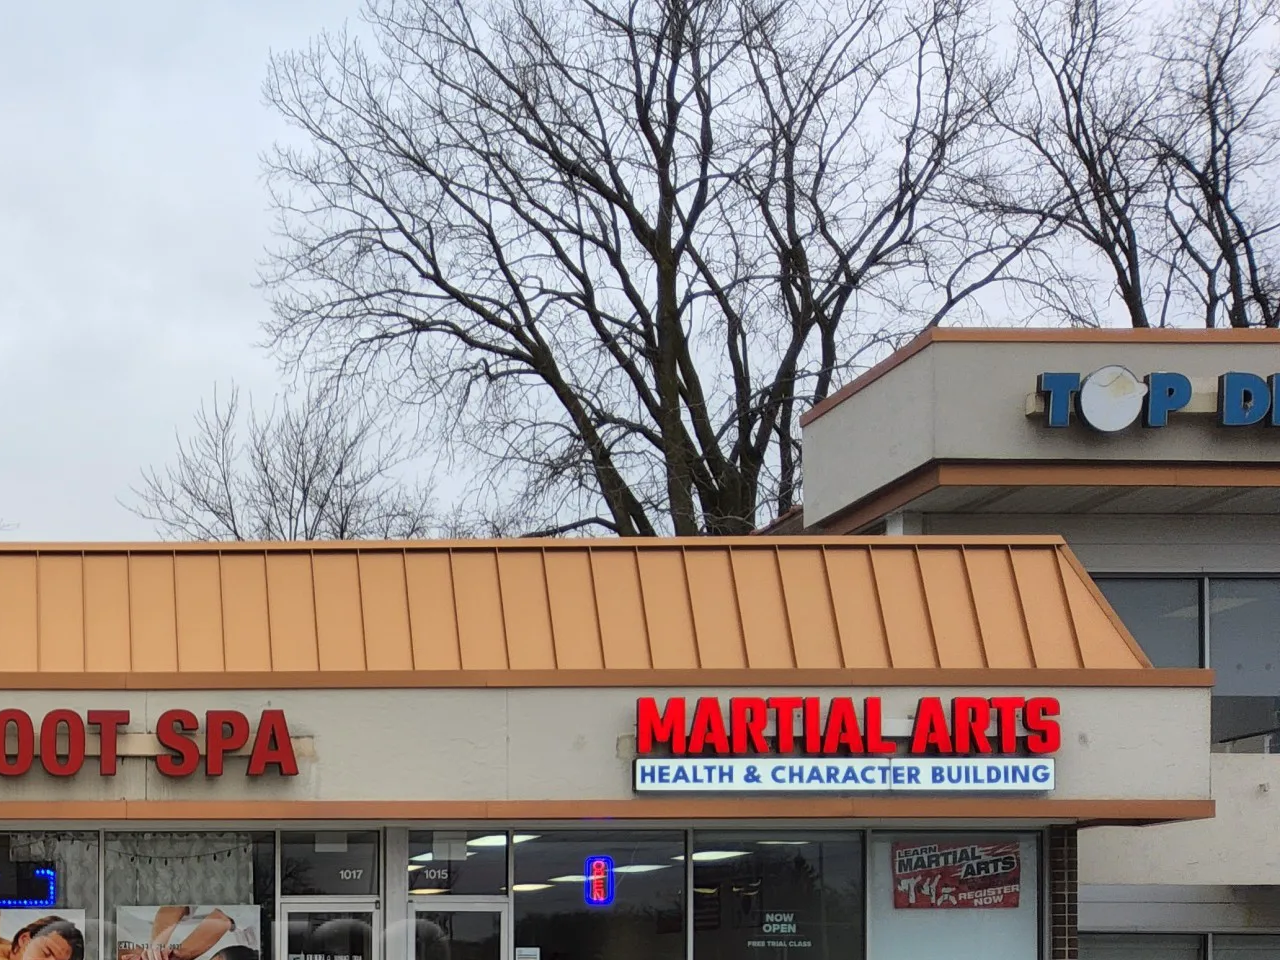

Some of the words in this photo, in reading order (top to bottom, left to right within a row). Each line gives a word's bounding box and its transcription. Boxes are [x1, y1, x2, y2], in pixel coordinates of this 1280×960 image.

[636, 696, 897, 754] MARTIAL
[911, 696, 1061, 754] ARTS
[155, 708, 299, 777] SPA
[639, 764, 735, 785] HEALTH
[743, 764, 763, 785] &
[770, 764, 922, 785] CHARACTER
[931, 764, 1051, 785] BUILDING
[897, 845, 938, 859] LEARN
[897, 846, 982, 873] MARTIAL
[339, 869, 363, 880] 1017
[423, 869, 448, 880] 1015
[962, 855, 1017, 879] ARTS
[593, 860, 605, 901] OPEN
[958, 884, 1020, 901] REGISTER
[973, 895, 1004, 907] NOW
[765, 912, 795, 922] NOW
[762, 923, 797, 933] OPEN
[747, 940, 766, 948] FREE
[766, 940, 787, 948] TRIAL
[788, 940, 812, 948] CLASS
